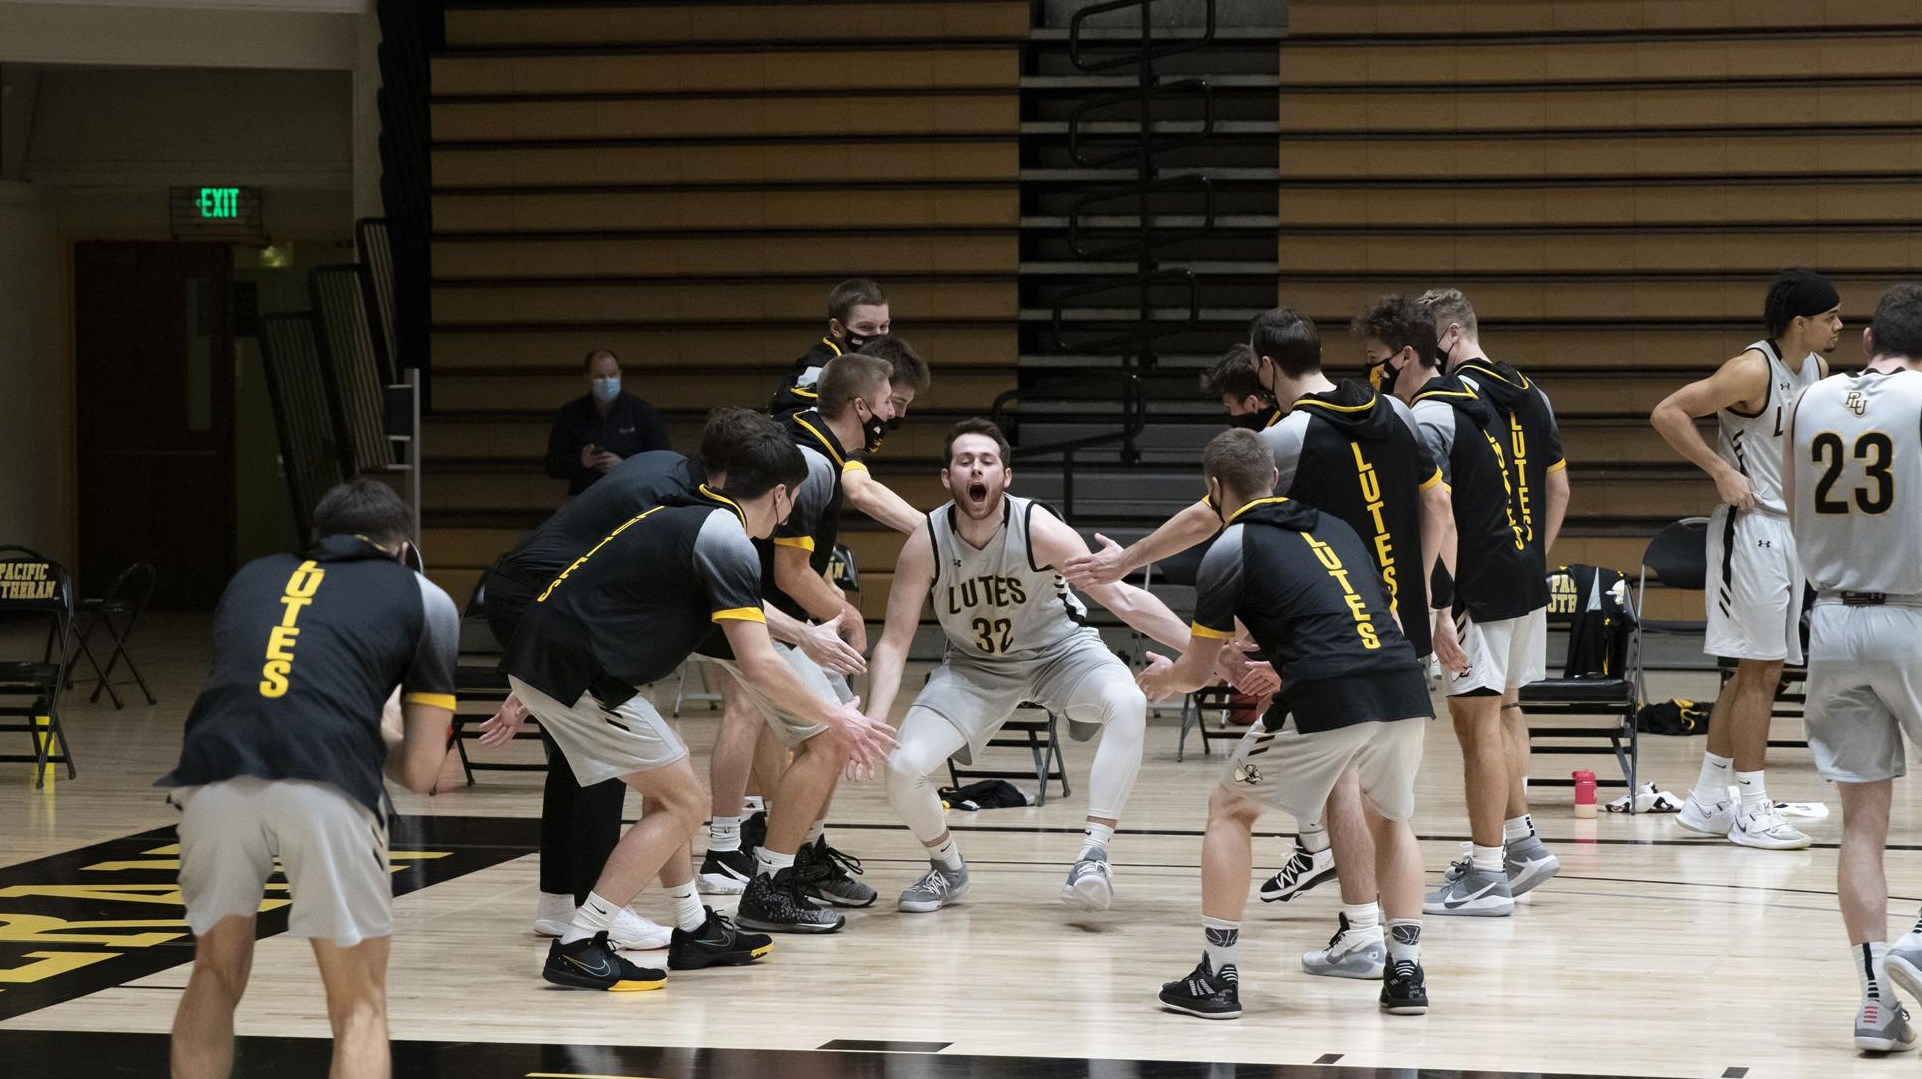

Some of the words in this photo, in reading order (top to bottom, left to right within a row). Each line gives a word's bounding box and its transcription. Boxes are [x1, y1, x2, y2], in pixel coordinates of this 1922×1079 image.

[201, 188, 239, 217] EXIT
[1812, 432, 1894, 514] 23
[1351, 441, 1398, 598] LUTES
[0, 563, 49, 580] PACIFIC
[0, 581, 56, 599] THERAN
[1300, 532, 1381, 649] LUTES
[950, 575, 1026, 615] LUTES
[972, 617, 1014, 653] 32
